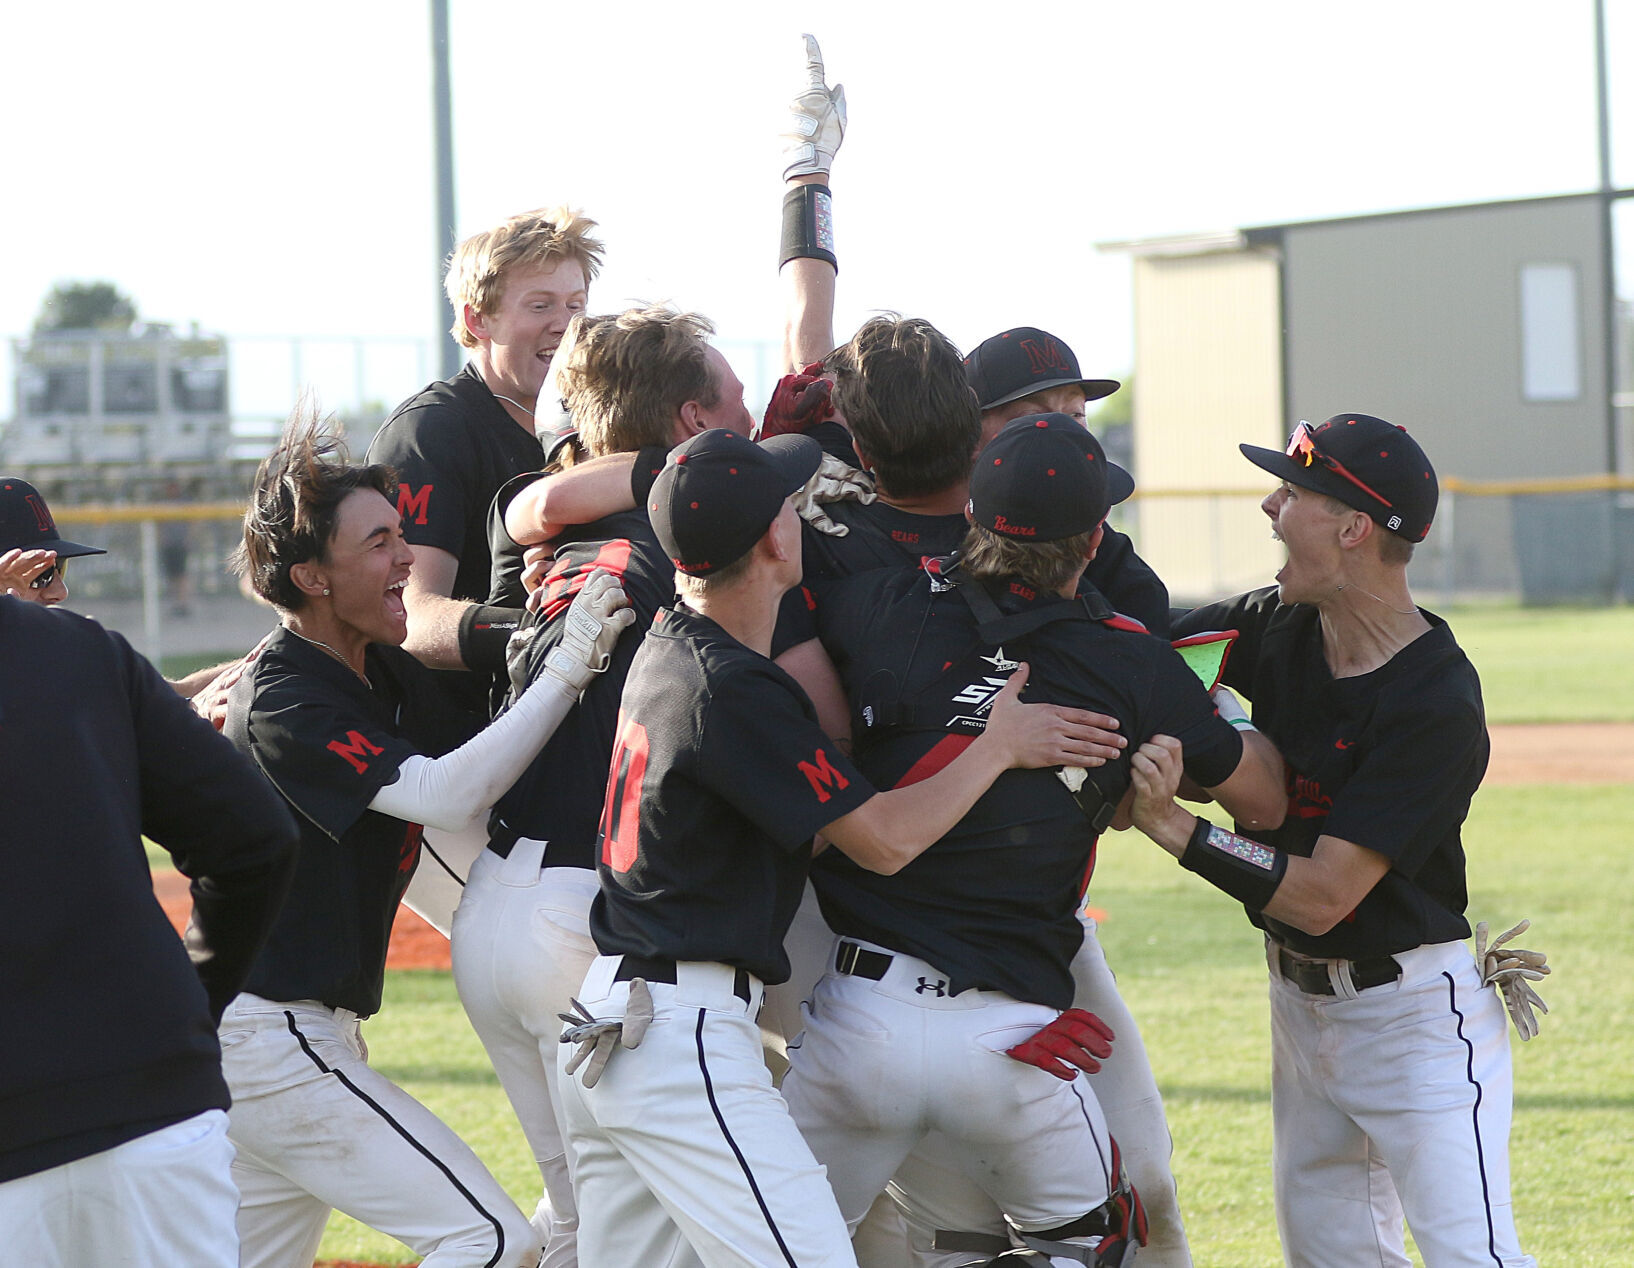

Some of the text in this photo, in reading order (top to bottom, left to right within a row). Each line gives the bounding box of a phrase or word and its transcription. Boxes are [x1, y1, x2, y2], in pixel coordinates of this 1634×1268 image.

[1020, 337, 1070, 374] M
[396, 483, 434, 525] M
[994, 515, 1036, 535] Bears
[326, 729, 384, 775] M
[797, 748, 850, 803] M
